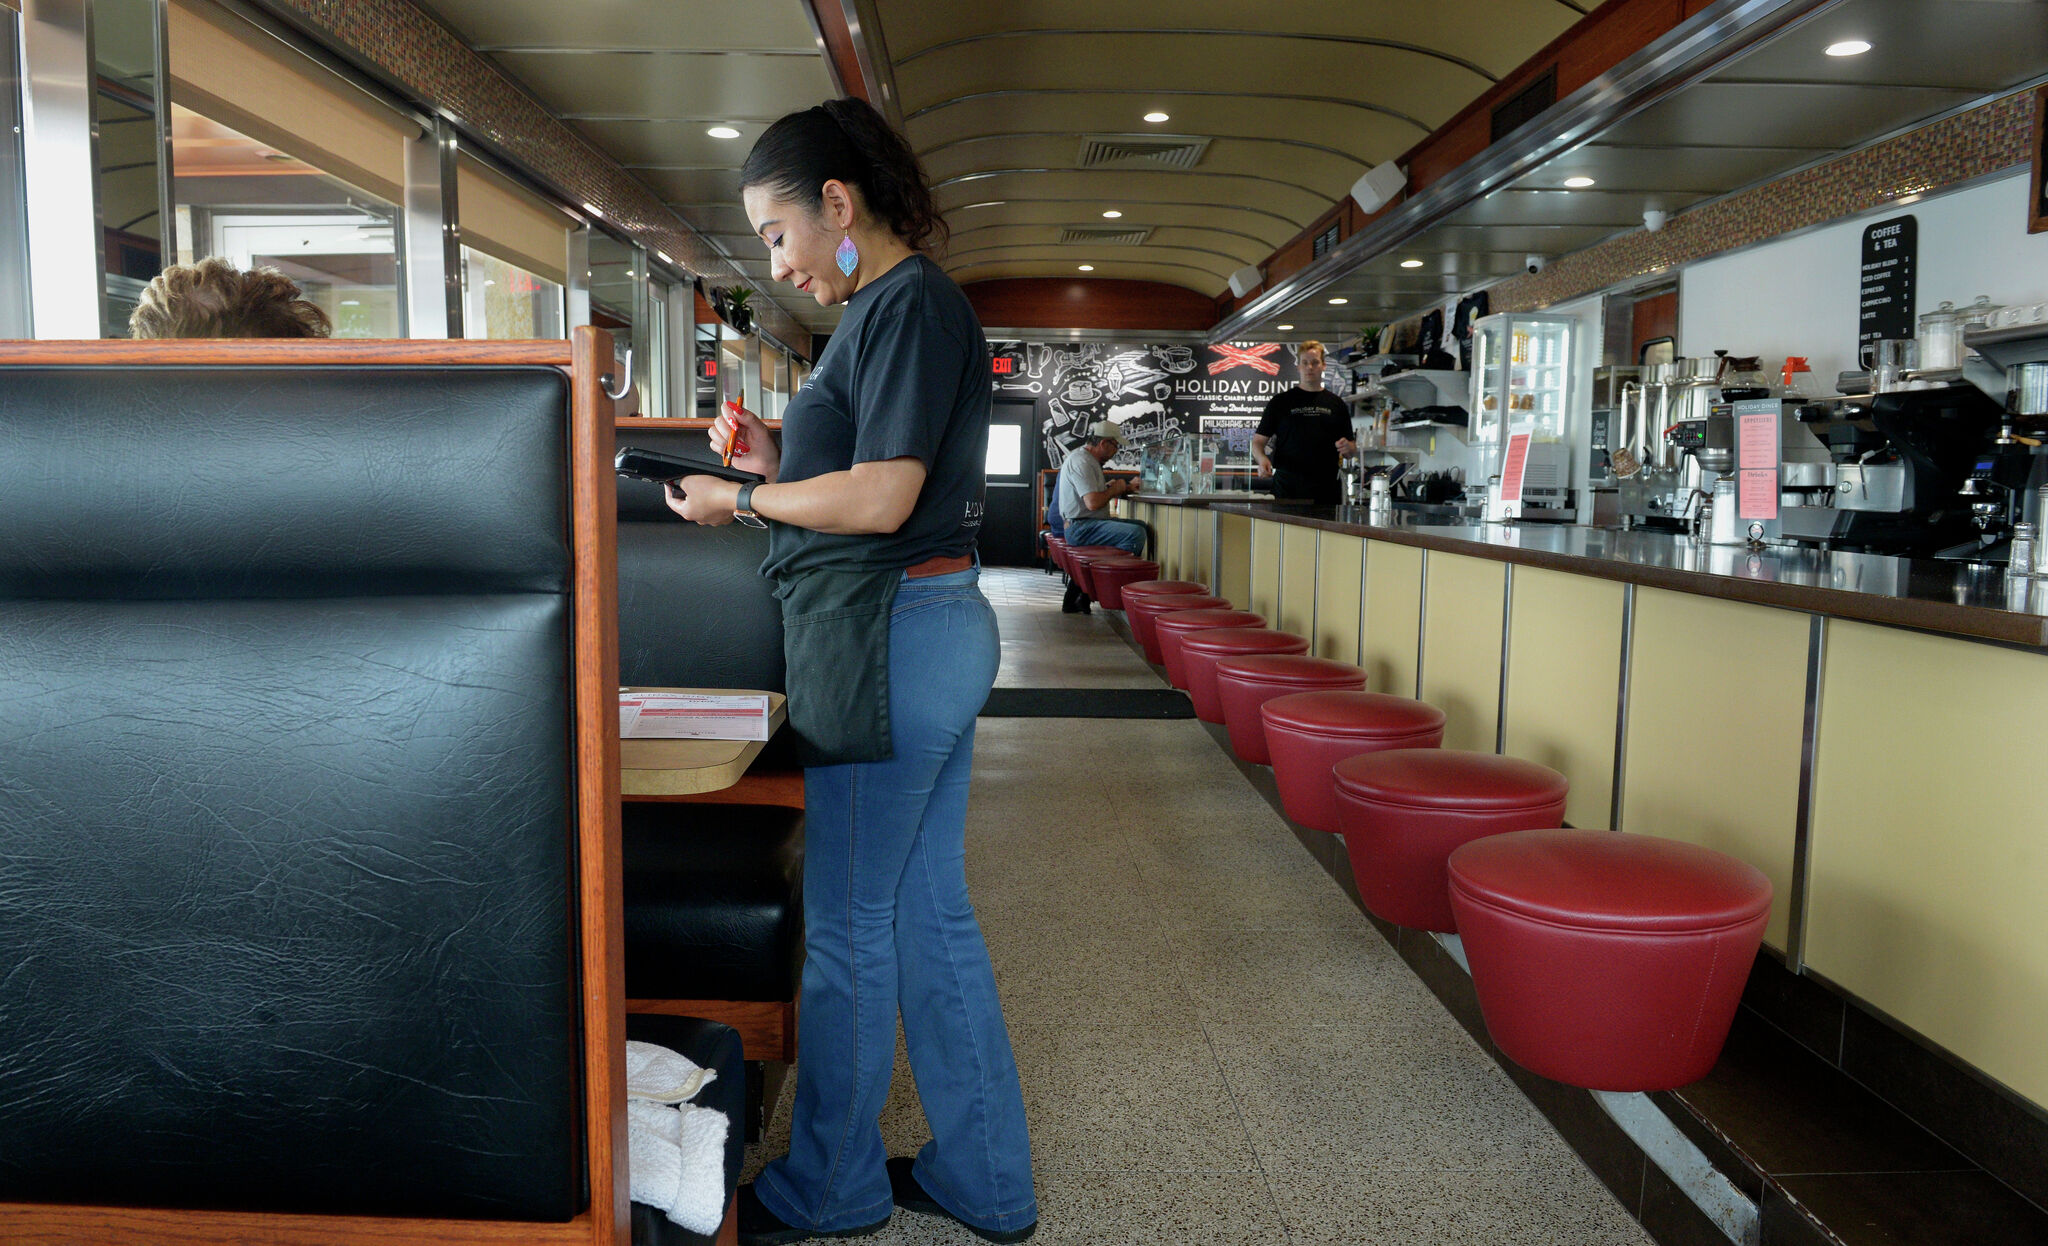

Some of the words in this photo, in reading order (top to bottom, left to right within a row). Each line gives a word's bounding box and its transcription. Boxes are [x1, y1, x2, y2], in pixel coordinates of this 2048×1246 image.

[1871, 224, 1901, 239] COFFEE
[1874, 241, 1881, 251] &
[1883, 238, 1898, 248] TEA
[1862, 274, 1873, 282] ICED
[1873, 271, 1891, 280] COFFEE
[1861, 285, 1884, 295] ESPRESSO
[1861, 311, 1876, 320] LATTE
[1860, 333, 1871, 341] HOT
[993, 357, 1013, 373] EXIT
[1175, 380, 1252, 394] HOLIDAY
[1258, 380, 1300, 394] DIN
